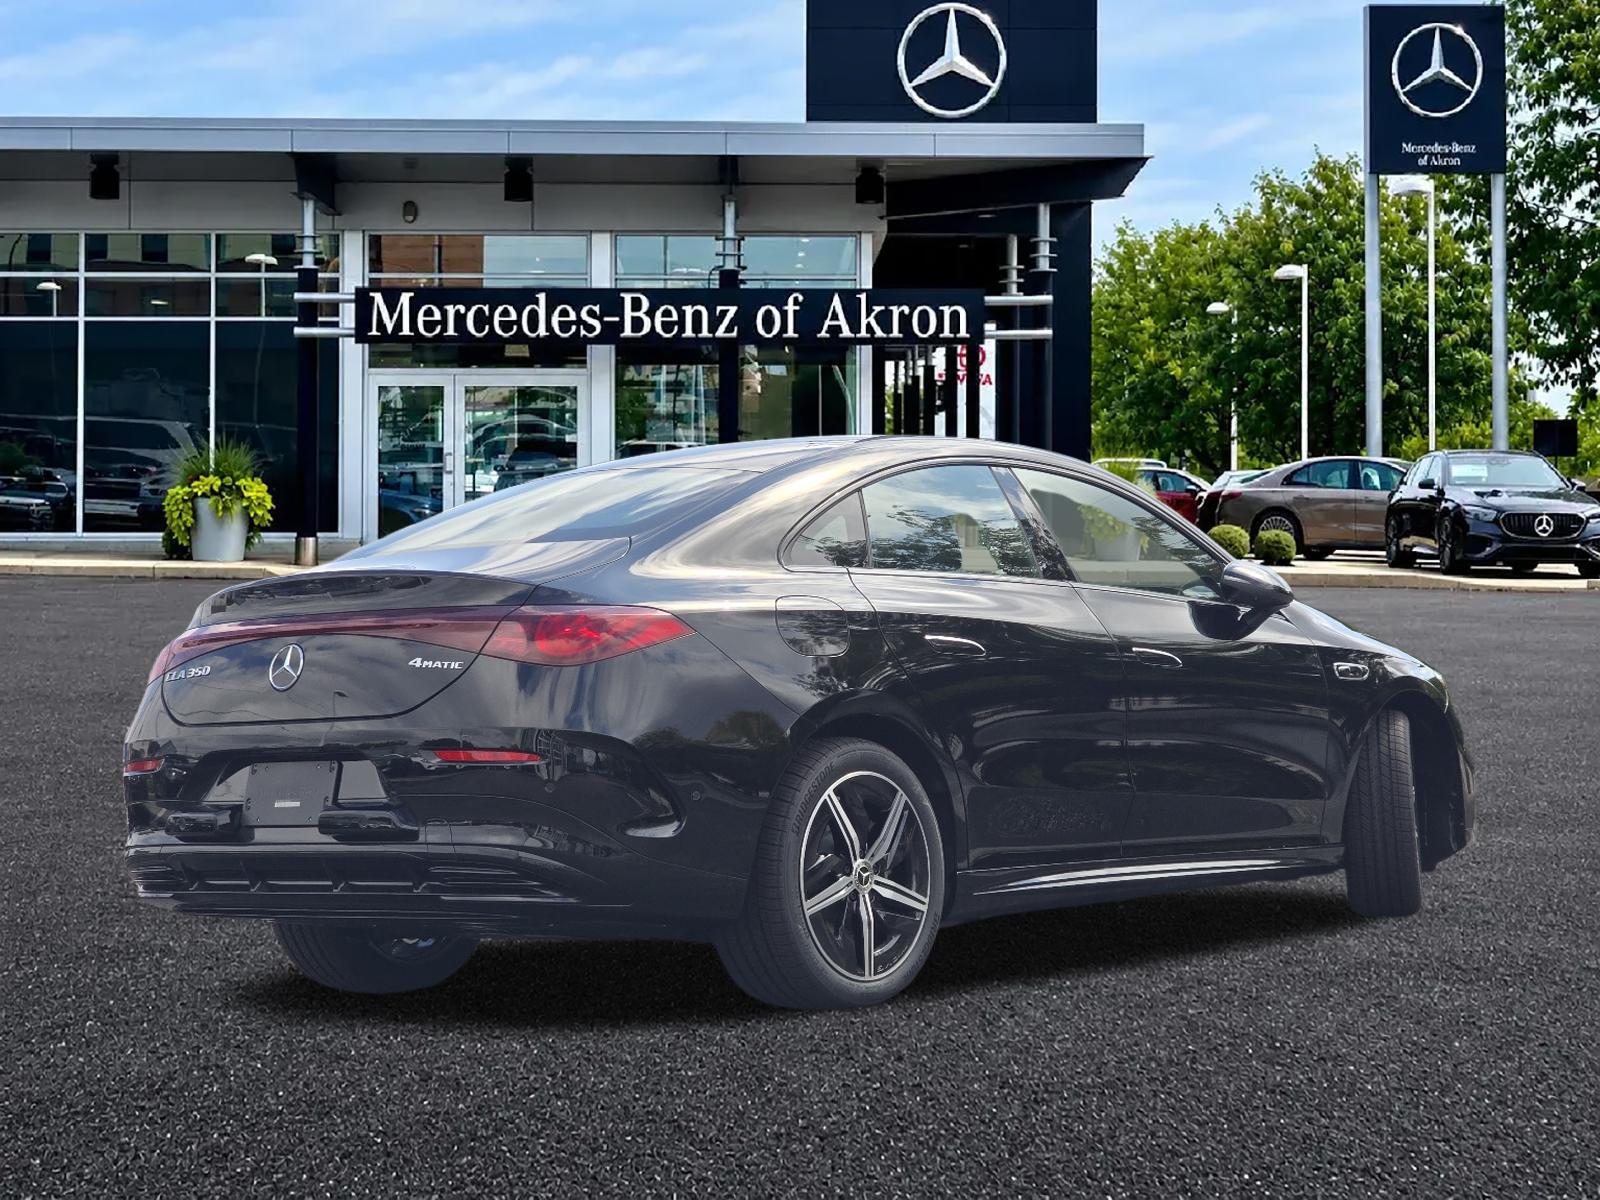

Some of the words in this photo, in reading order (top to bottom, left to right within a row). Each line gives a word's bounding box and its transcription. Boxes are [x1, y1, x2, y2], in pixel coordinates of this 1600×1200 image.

[1401, 142, 1476, 153] Mercedes-Benz
[1417, 154, 1428, 165] of
[1430, 154, 1461, 165] Akron
[367, 291, 738, 339] Mercedes-Benz
[755, 291, 804, 339] of
[816, 291, 971, 339] Akron
[408, 657, 464, 669] 4MATIC
[165, 669, 187, 681] CLA
[186, 665, 211, 679] 350
[792, 761, 835, 836] BRIDGESTONE
